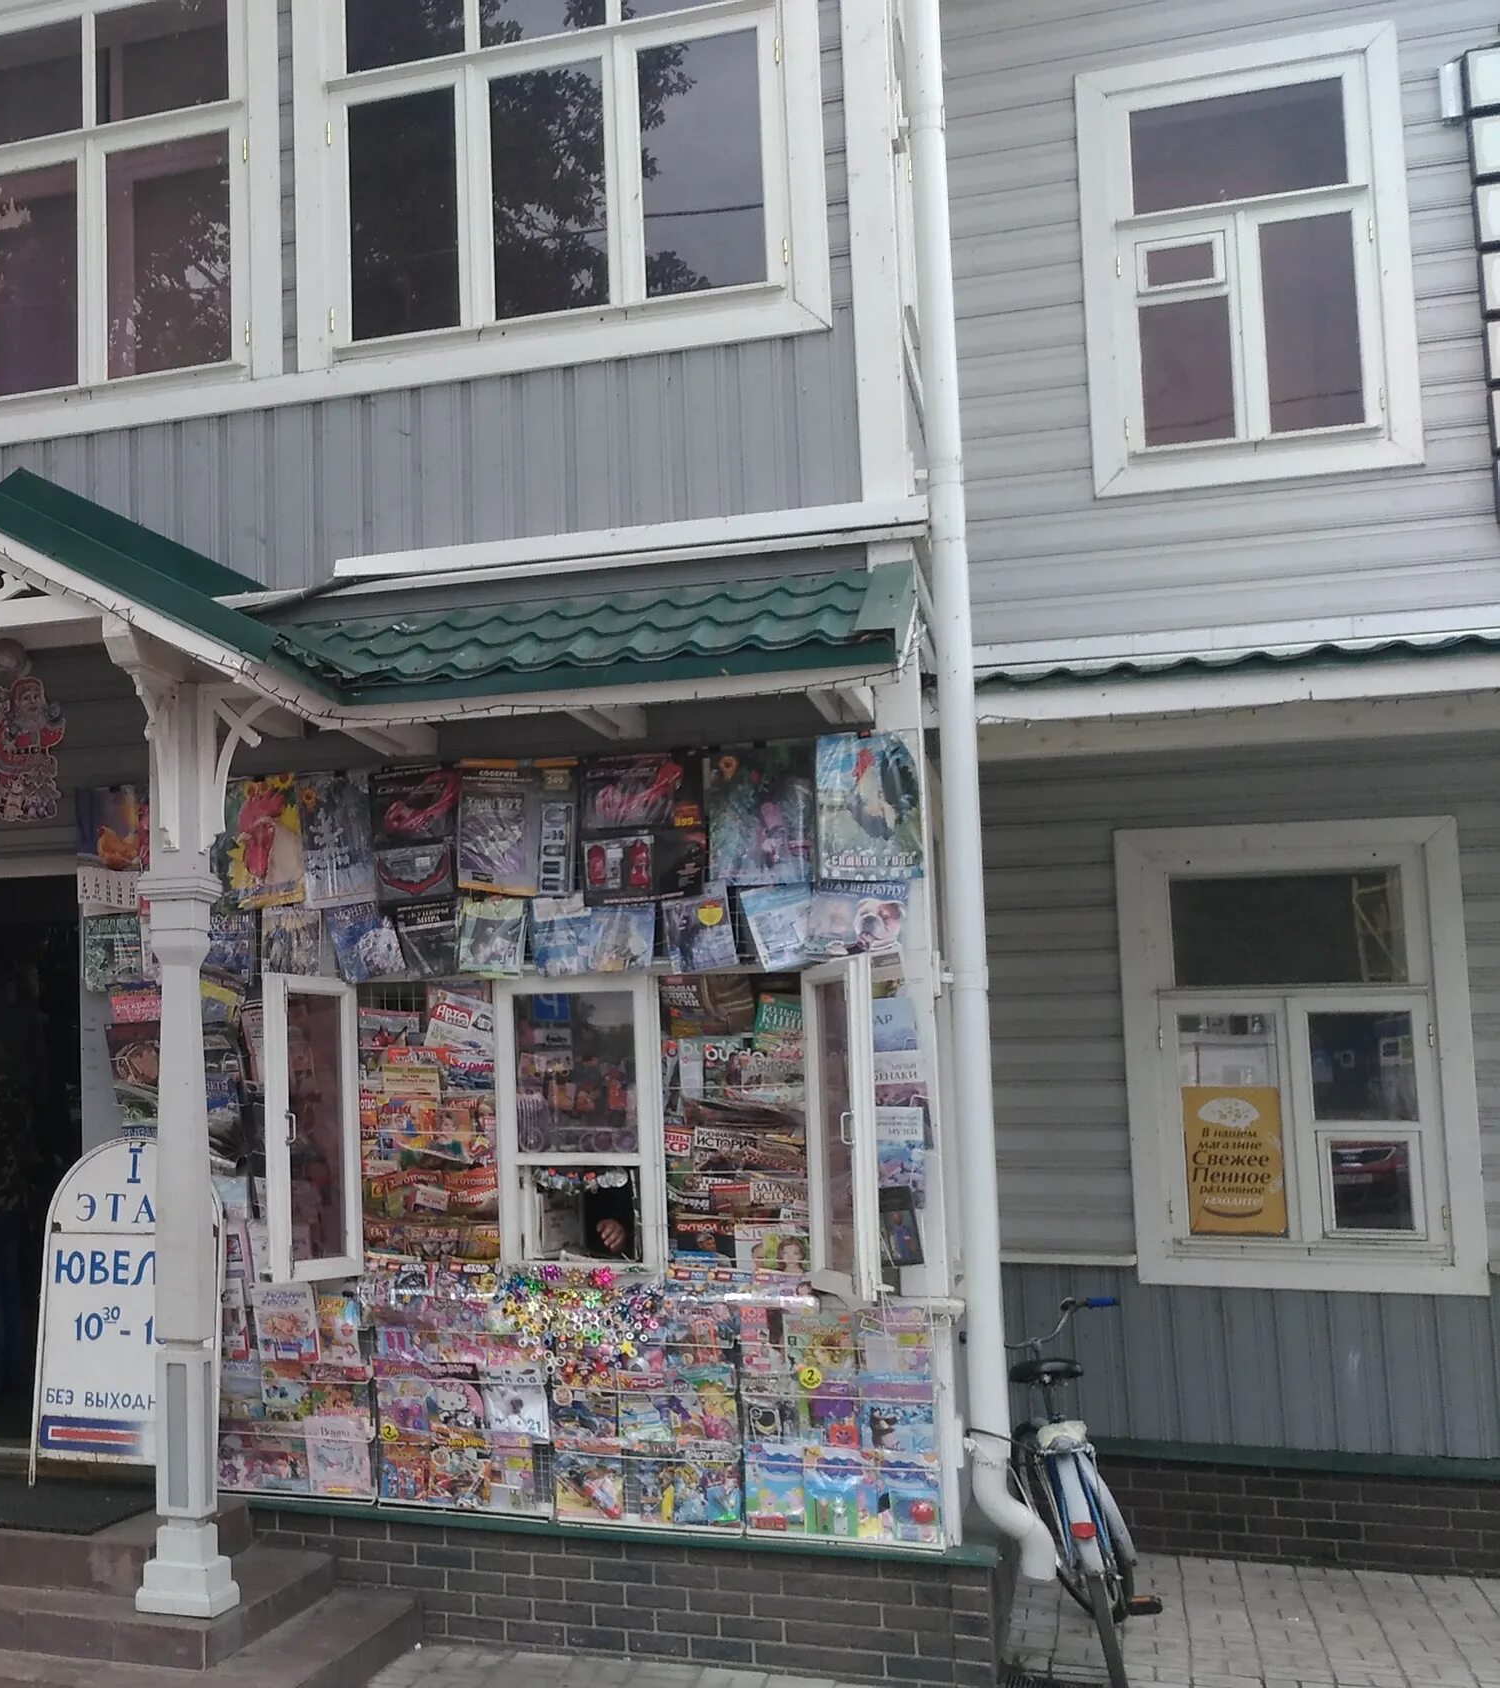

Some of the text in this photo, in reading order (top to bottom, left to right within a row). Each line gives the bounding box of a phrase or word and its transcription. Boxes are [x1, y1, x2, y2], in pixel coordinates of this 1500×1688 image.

[1202, 1127, 1257, 1138] В нашем
[696, 1137, 757, 1150] ИСТОРИЯ
[1191, 1150, 1270, 1167] Свежее
[1192, 1166, 1272, 1184] Пенное
[807, 1370, 815, 1381] 2
